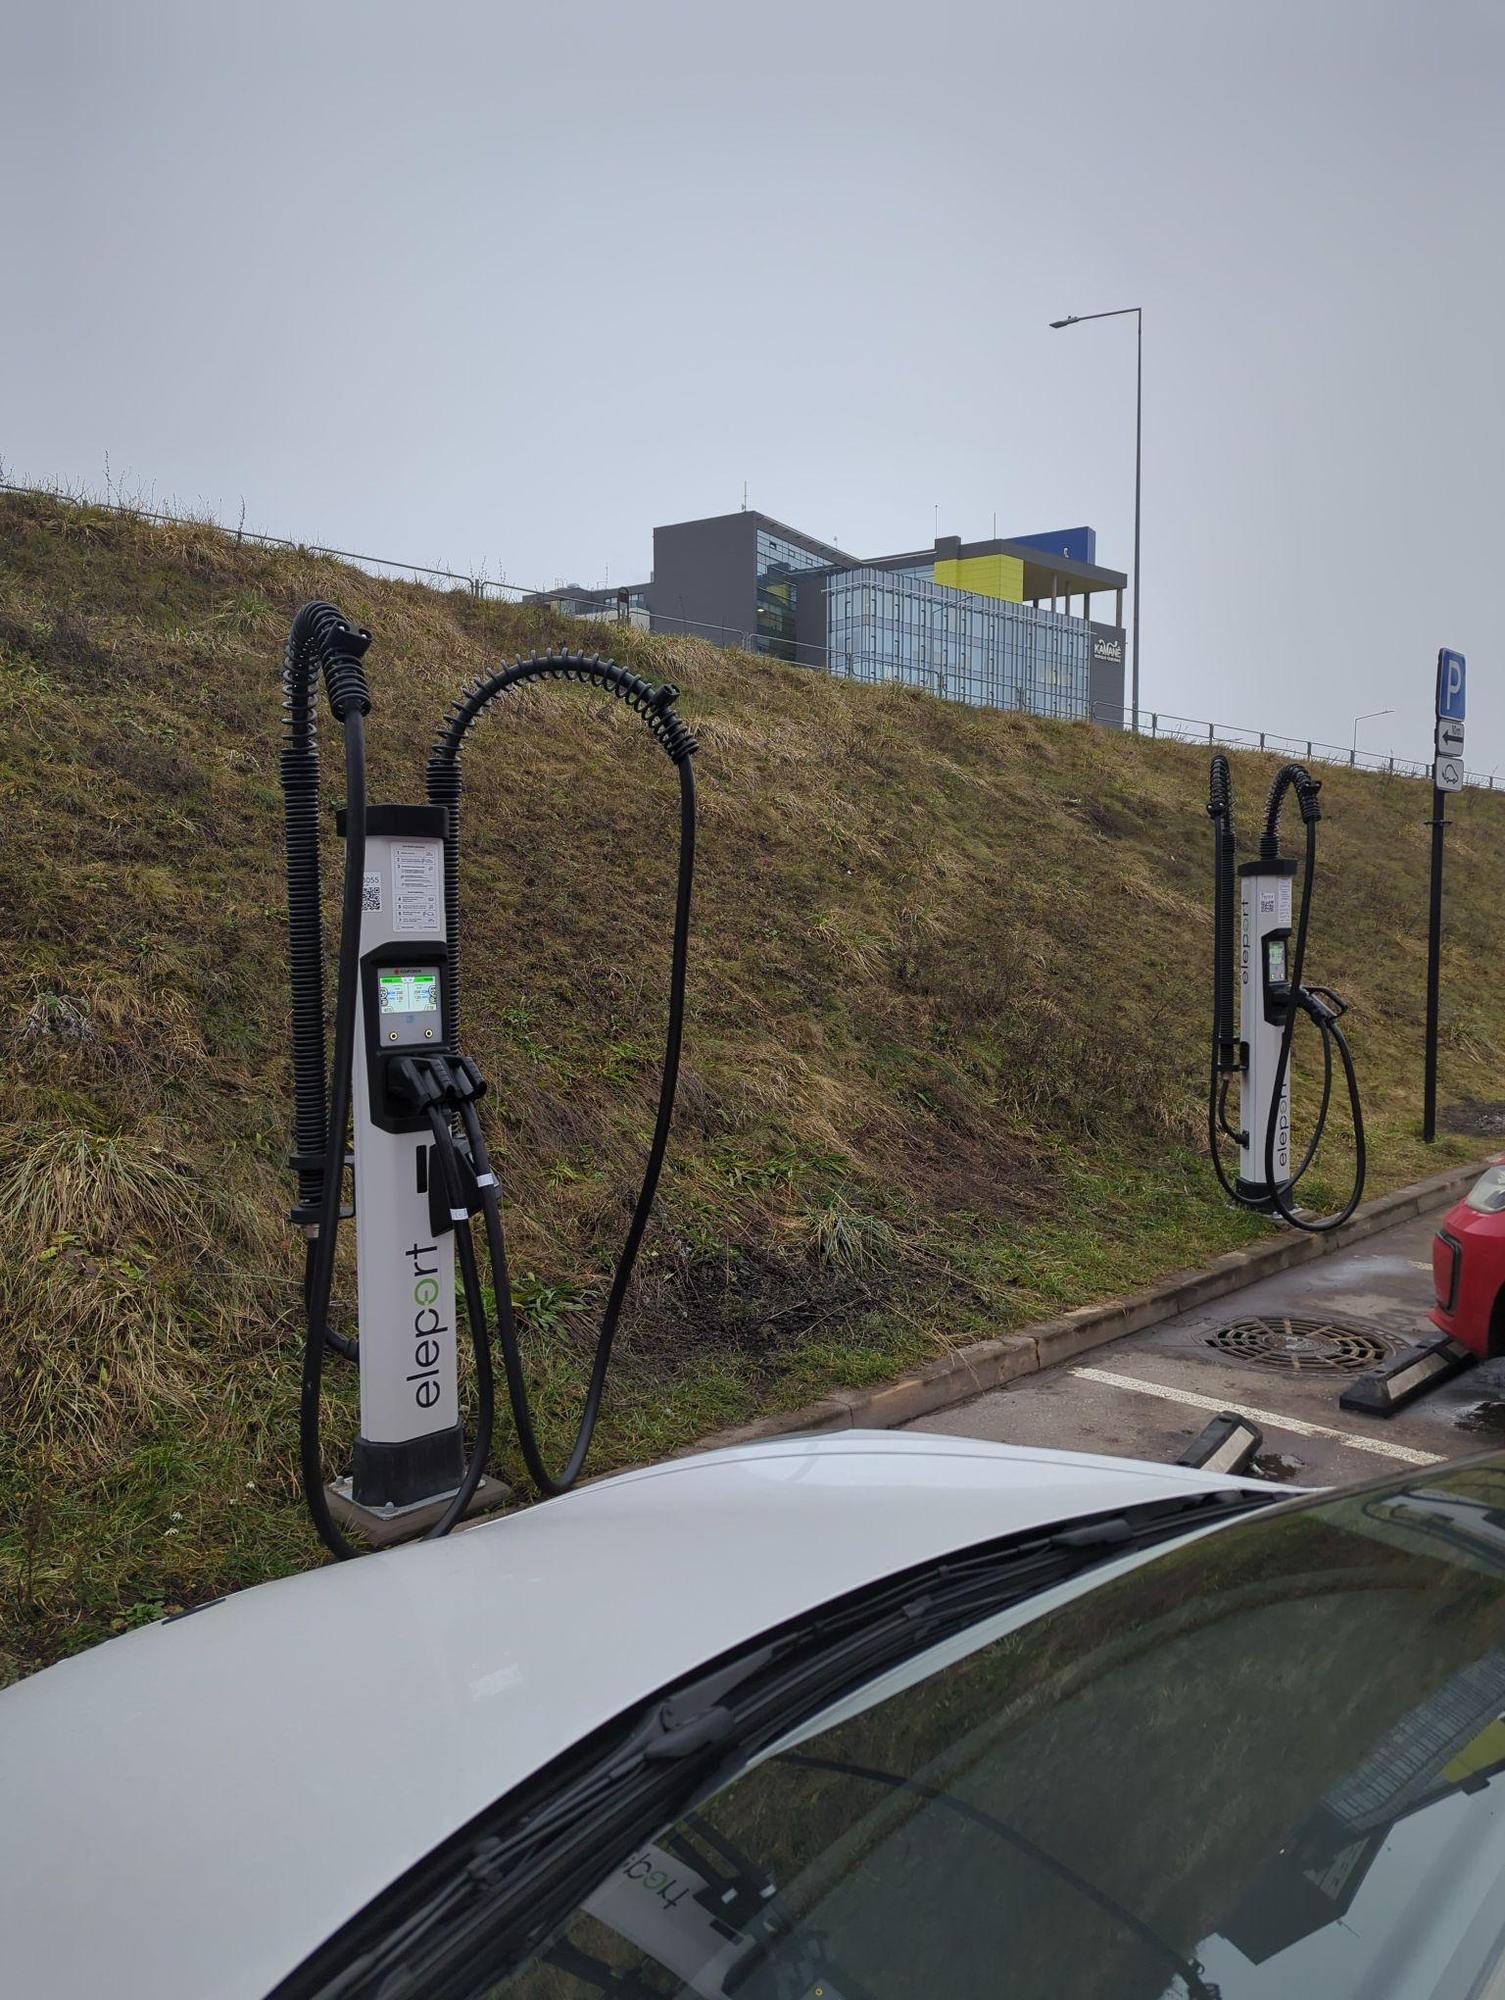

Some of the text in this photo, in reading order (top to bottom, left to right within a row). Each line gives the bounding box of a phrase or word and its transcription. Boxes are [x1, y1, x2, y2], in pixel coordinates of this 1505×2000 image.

[1447, 660, 1462, 710] P
[1241, 901, 1250, 985] eleport
[405, 1243, 448, 1409] eleport
